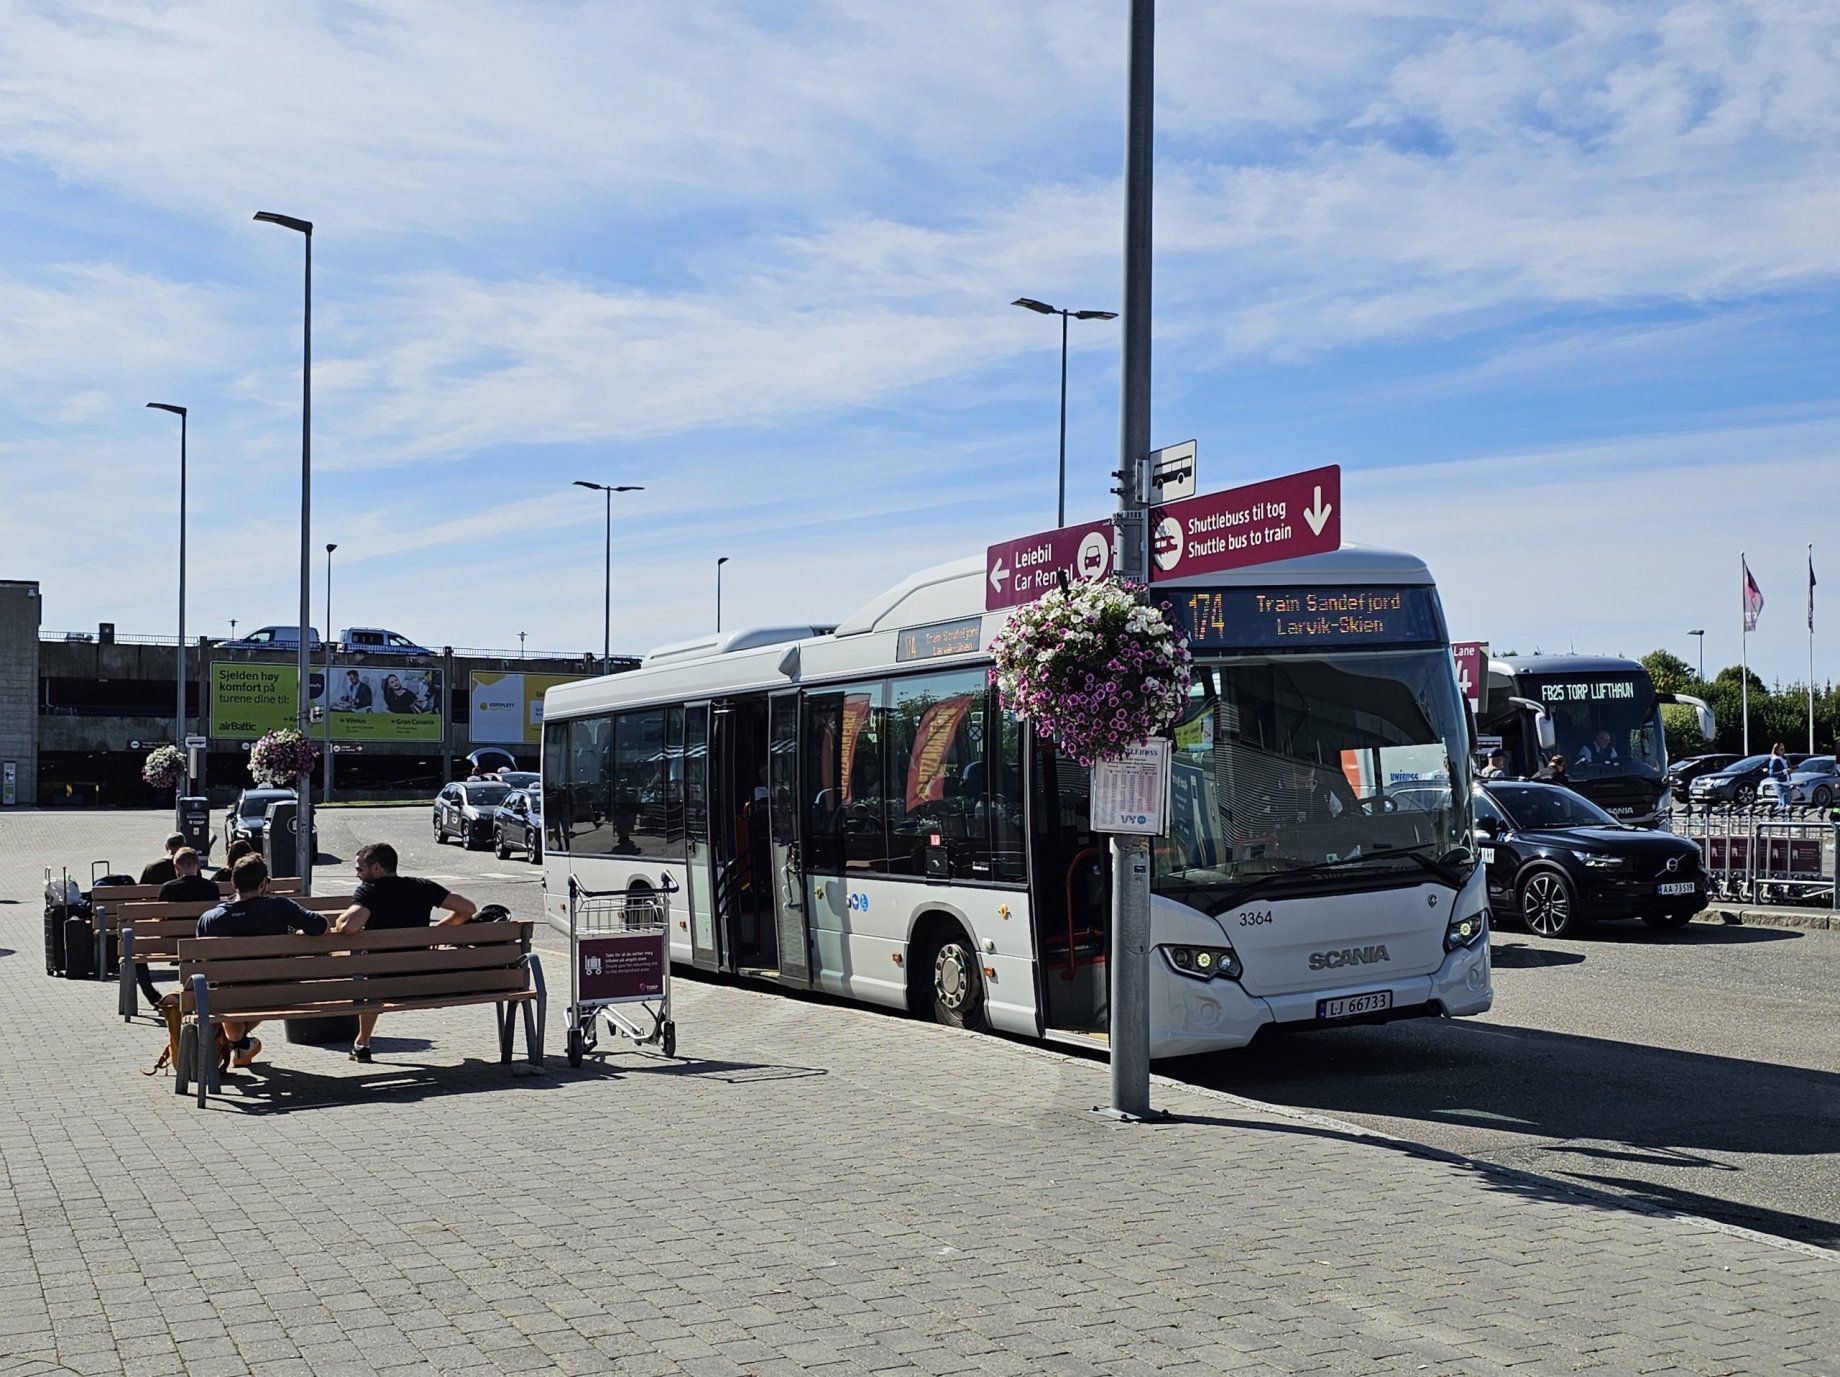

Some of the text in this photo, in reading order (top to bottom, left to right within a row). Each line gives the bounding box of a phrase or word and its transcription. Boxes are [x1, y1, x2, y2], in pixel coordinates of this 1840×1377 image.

[1188, 502, 1286, 535] Shuttlebuss til tog
[1188, 523, 1292, 558] Shuttle bus to train
[1015, 543, 1052, 568] Leiebil
[1015, 563, 1073, 591] Car Renal
[1256, 593, 1400, 613] Train Sandefjord
[1188, 593, 1225, 640] 174
[1276, 616, 1384, 635] Larvik-Skien
[1453, 645, 1475, 657] Lane
[219, 670, 279, 683] Sjelden høy
[1456, 659, 1472, 694] 4
[219, 682, 275, 694] komfort på
[1566, 683, 1588, 700] TORP
[219, 694, 289, 705] turene dine til:
[219, 721, 256, 731] airBaltic
[1239, 910, 1273, 927] 3364
[1308, 944, 1390, 971] SCANIA
[1330, 994, 1386, 1016] LJ 66733
